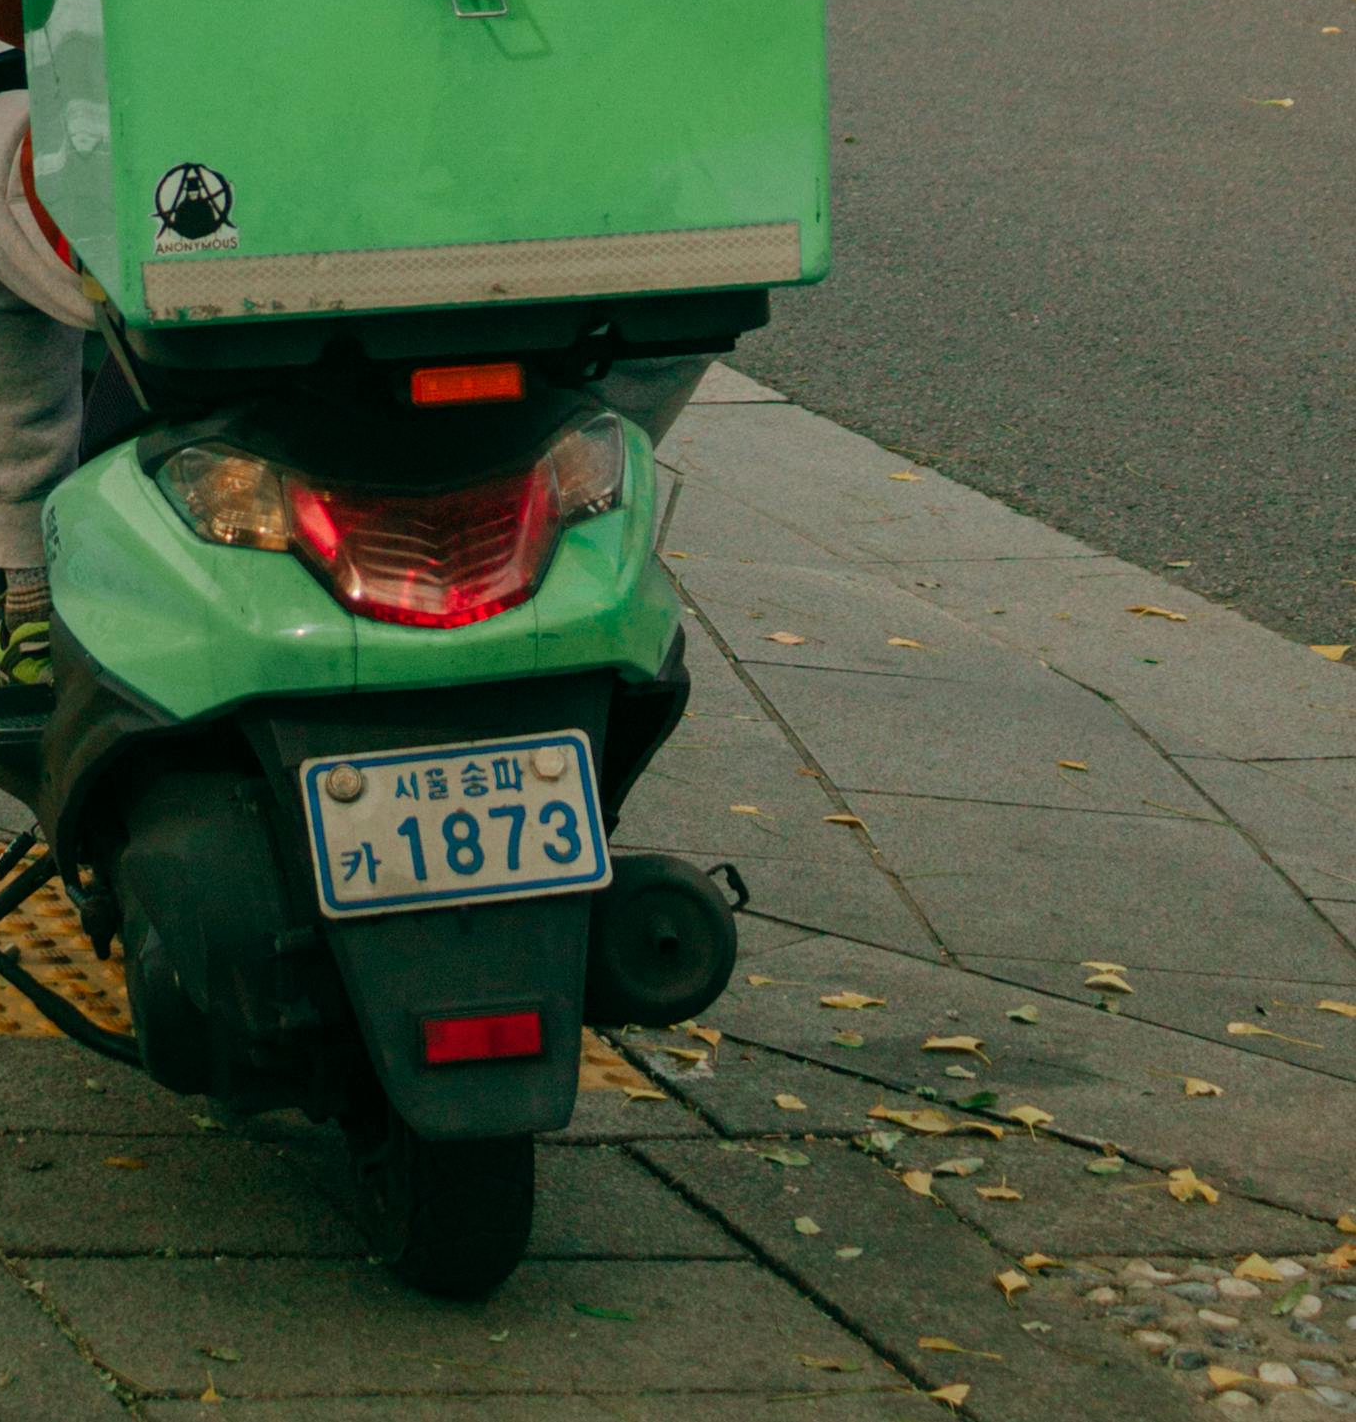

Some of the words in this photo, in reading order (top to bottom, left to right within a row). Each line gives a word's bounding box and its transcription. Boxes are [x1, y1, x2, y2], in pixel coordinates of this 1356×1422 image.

[155, 237, 238, 254] ANONYMOUS
[395, 767, 449, 801] 서울
[460, 757, 524, 798] 송파
[340, 841, 382, 884] 카
[396, 800, 582, 881] 1873
